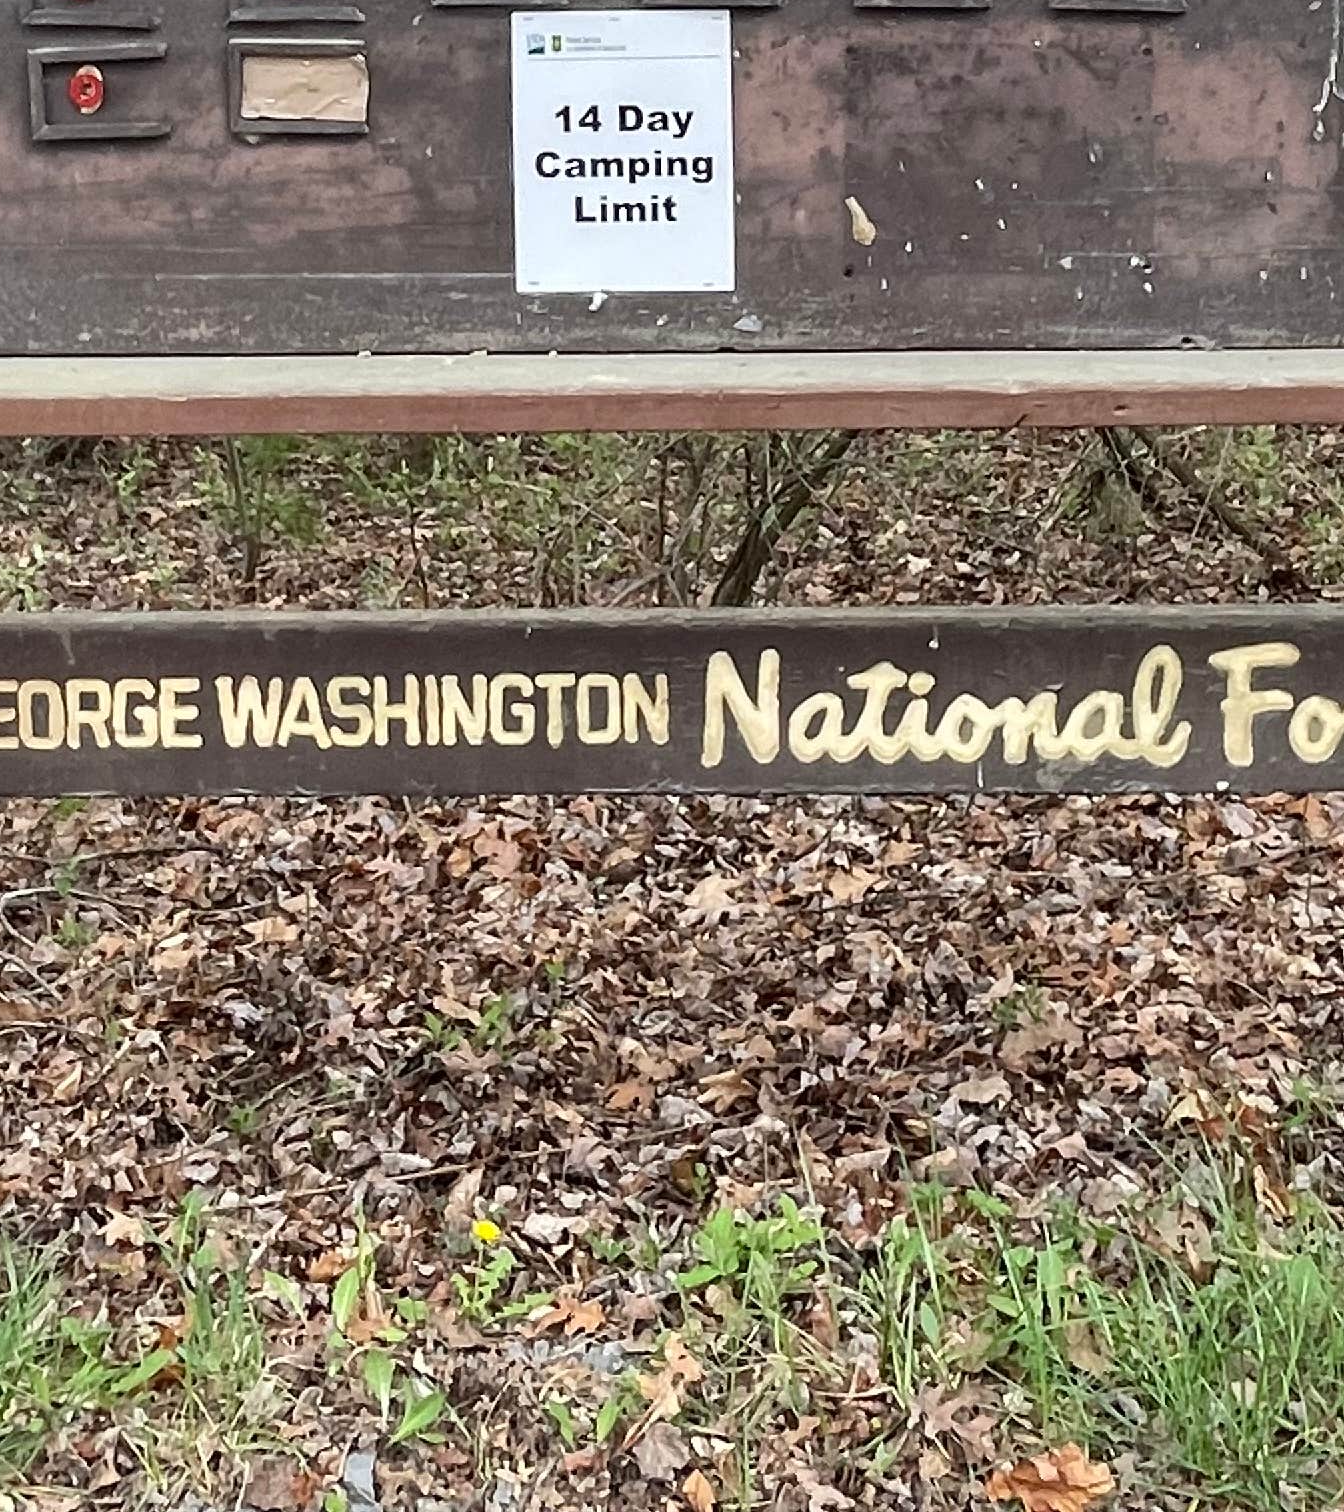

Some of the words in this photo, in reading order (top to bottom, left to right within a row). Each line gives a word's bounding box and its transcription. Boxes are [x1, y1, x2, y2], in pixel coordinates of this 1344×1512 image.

[554, 104, 602, 133] 14
[617, 104, 694, 139] Day
[534, 150, 714, 184] Camping
[574, 194, 678, 223] Limit
[215, 672, 670, 749] WASHINGTON
[702, 642, 1192, 768] National
